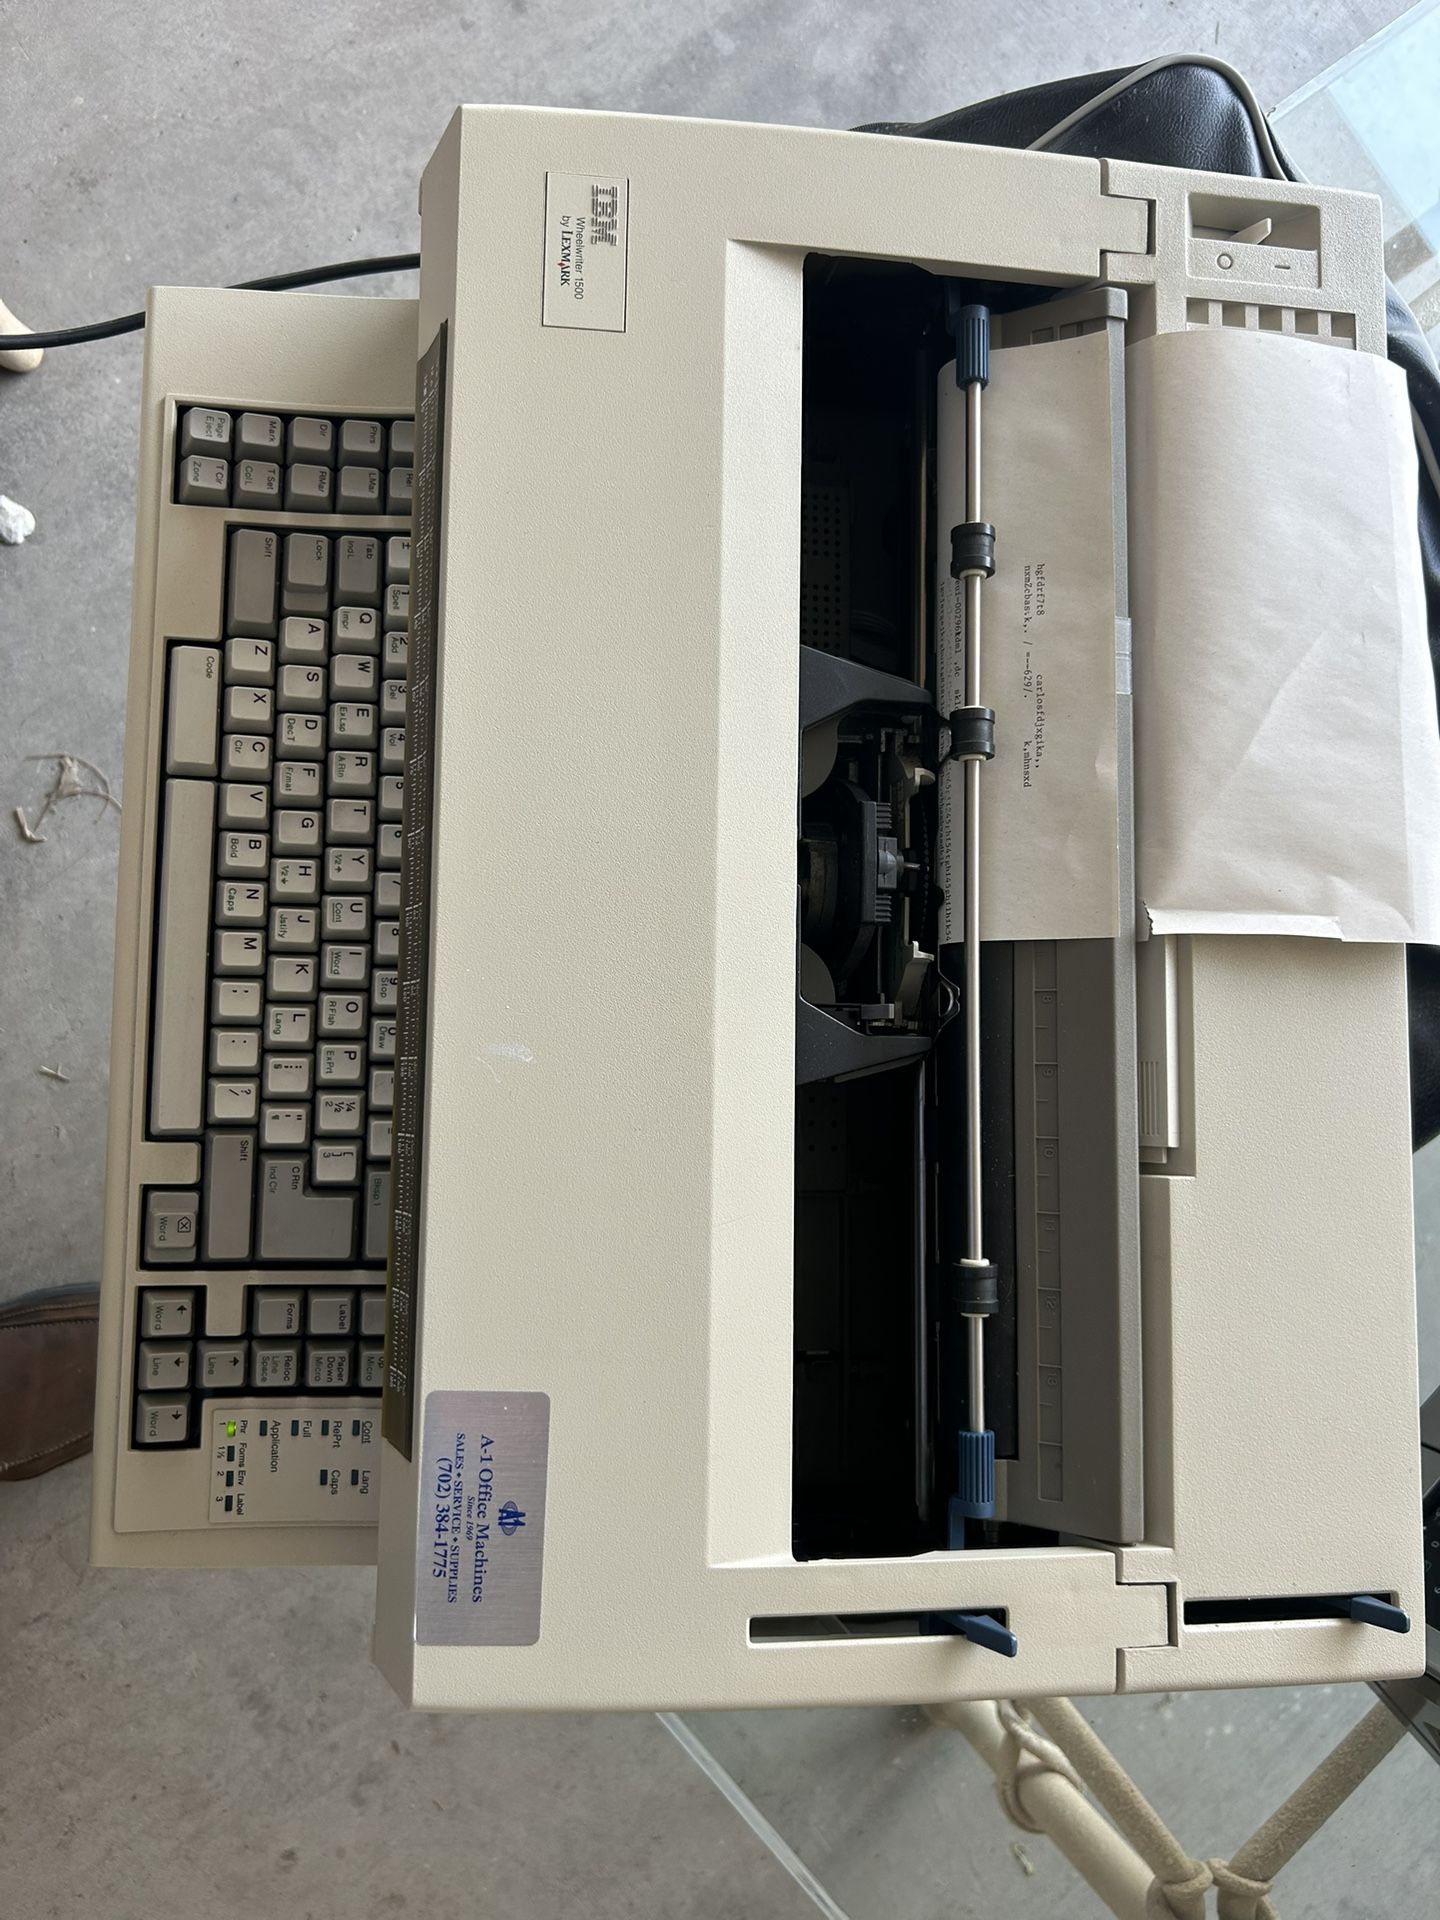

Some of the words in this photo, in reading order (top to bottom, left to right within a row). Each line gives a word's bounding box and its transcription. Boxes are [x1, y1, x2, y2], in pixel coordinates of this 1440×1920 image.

[560, 215, 571, 227] by
[591, 185, 618, 246] IBM
[575, 216, 586, 274] Wheelwriter
[557, 230, 574, 286] LEXMARK
[574, 277, 584, 300] 1500
[204, 415, 214, 438] Eject
[216, 417, 225, 439] Page
[268, 421, 277, 442] Mark
[319, 424, 328, 437] Dir
[192, 461, 201, 482] Zone
[264, 537, 274, 559] Shift
[315, 539, 324, 561] Lock
[365, 543, 375, 560] Tab
[391, 589, 401, 610] Spell
[308, 623, 321, 634] A
[341, 611, 351, 630] Impr
[359, 612, 372, 625] Q
[255, 645, 268, 656] Z
[391, 636, 399, 654] Add
[205, 656, 215, 679] Code
[306, 672, 320, 682] S
[357, 661, 371, 673] W
[253, 692, 267, 704] X
[389, 685, 398, 700] Del
[356, 708, 370, 718] E
[305, 719, 318, 730] D
[234, 740, 243, 753] Ctr
[252, 741, 265, 752] C
[389, 733, 397, 747] Vol
[355, 756, 368, 767] R
[284, 767, 293, 792] Frmat
[302, 768, 315, 778] F
[250, 791, 263, 802] V
[353, 805, 367, 816] T
[301, 817, 314, 829] G
[230, 838, 239, 858] Bold
[249, 839, 262, 850] B
[352, 855, 365, 865] Y
[298, 865, 312, 877] H
[226, 887, 237, 912] Caps
[246, 889, 259, 900] N
[334, 902, 343, 923] Cont
[350, 902, 363, 913] U
[297, 915, 310, 923] J
[244, 937, 257, 950] M
[295, 964, 309, 975] K
[333, 951, 342, 975] Word
[380, 977, 389, 998] Stop
[346, 1001, 359, 1013] O
[273, 1013, 283, 1035] Lang
[293, 1013, 305, 1023] L
[378, 1026, 387, 1049] Draw
[343, 1050, 357, 1061] P
[239, 1140, 249, 1162] Shift
[269, 1166, 278, 1180] Ind
[373, 1178, 383, 1200] Bksp
[158, 1216, 168, 1242] Word
[154, 1305, 164, 1331] Word
[286, 1303, 295, 1330] Forms
[338, 1304, 347, 1330] Label
[151, 1357, 161, 1376] Line
[207, 1356, 217, 1375] Line
[259, 1355, 270, 1382] Space
[271, 1356, 280, 1374] Line
[283, 1355, 292, 1381] Reloc
[314, 1356, 323, 1382] Micro
[326, 1356, 335, 1383] Down
[335, 1356, 345, 1382] Paper
[365, 1356, 375, 1381] Micro
[149, 1411, 159, 1437] Word
[240, 1419, 248, 1434] Phr
[302, 1420, 312, 1438] Full
[332, 1420, 342, 1448] RePrt
[362, 1420, 373, 1444] Cont
[238, 1442, 247, 1468] Forms
[269, 1420, 280, 1473] Application
[454, 1432, 466, 1470] SALES
[479, 1434, 495, 1463] A-1
[238, 1470, 246, 1486] Env
[330, 1469, 340, 1495] Caps
[359, 1470, 371, 1495] Lang
[434, 1457, 453, 1499] (702)
[476, 1468, 494, 1519] Office
[236, 1493, 245, 1516] Label
[451, 1480, 464, 1534] SERVICE
[466, 1495, 476, 1519] Since
[432, 1504, 451, 1578] 384-1775
[465, 1520, 474, 1541] 1969
[447, 1544, 460, 1604] SUPPLIES
[472, 1523, 490, 1604] Machines
